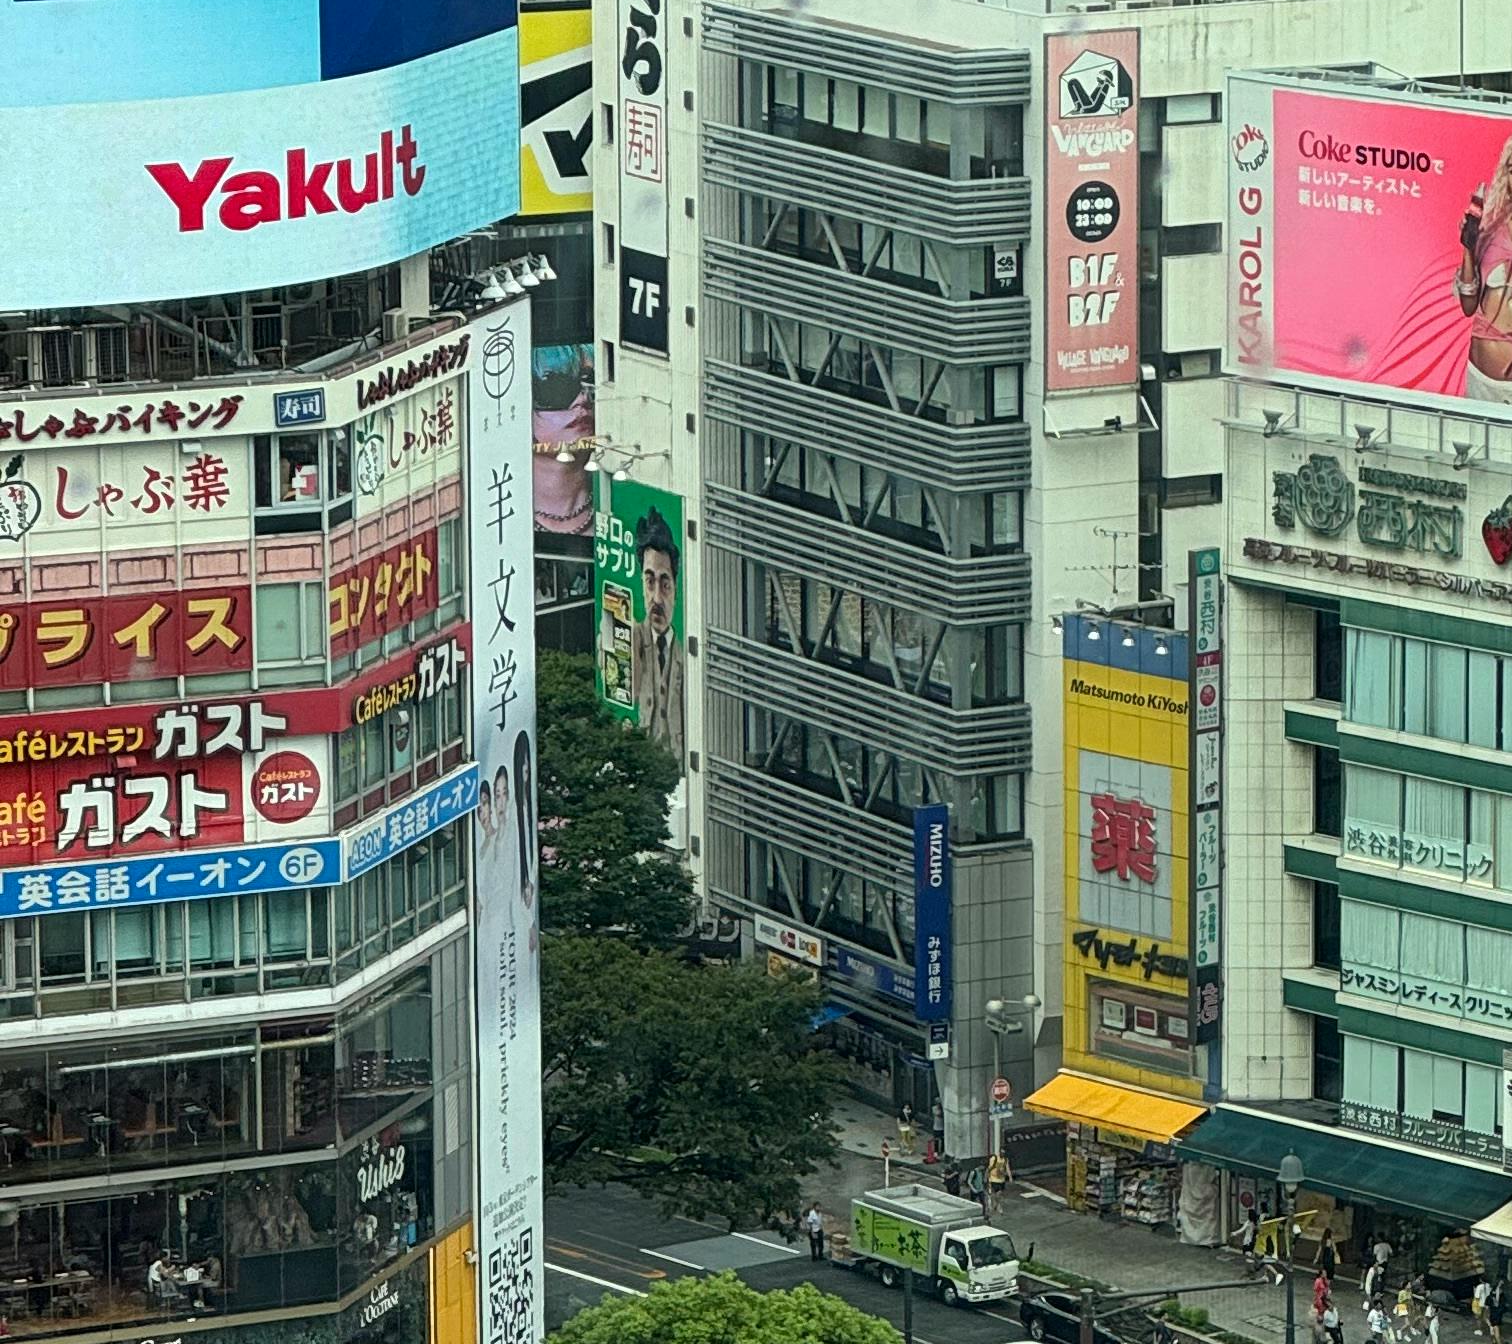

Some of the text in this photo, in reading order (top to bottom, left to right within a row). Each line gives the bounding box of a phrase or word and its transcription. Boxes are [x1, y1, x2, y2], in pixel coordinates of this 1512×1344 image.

[1051, 125, 1134, 156] VANGUARD
[1298, 130, 1351, 163] Coke
[145, 124, 427, 235] Yakult
[1298, 165, 1422, 198] 新しいアーティストと
[1298, 189, 1382, 216] 新しい音楽を。
[628, 277, 661, 319] 7F
[1068, 252, 1118, 288] B1F
[1237, 187, 1263, 364] KAROL G
[1068, 290, 1120, 327] B2F
[280, 394, 321, 421] 寿司
[56, 454, 230, 520] しゃぶ葉
[486, 460, 518, 734] 羊文学
[418, 639, 465, 702] ガスト
[1070, 678, 1146, 707] Matsumoto
[155, 702, 287, 759] ガスト
[57, 774, 227, 851] ガスト
[261, 783, 313, 805] ガスト
[929, 823, 943, 887] MIZUHO
[1090, 792, 1158, 885] 薬
[18, 855, 319, 912] 英会話イーオン 6F
[927, 936, 942, 1004] みずほ銀行
